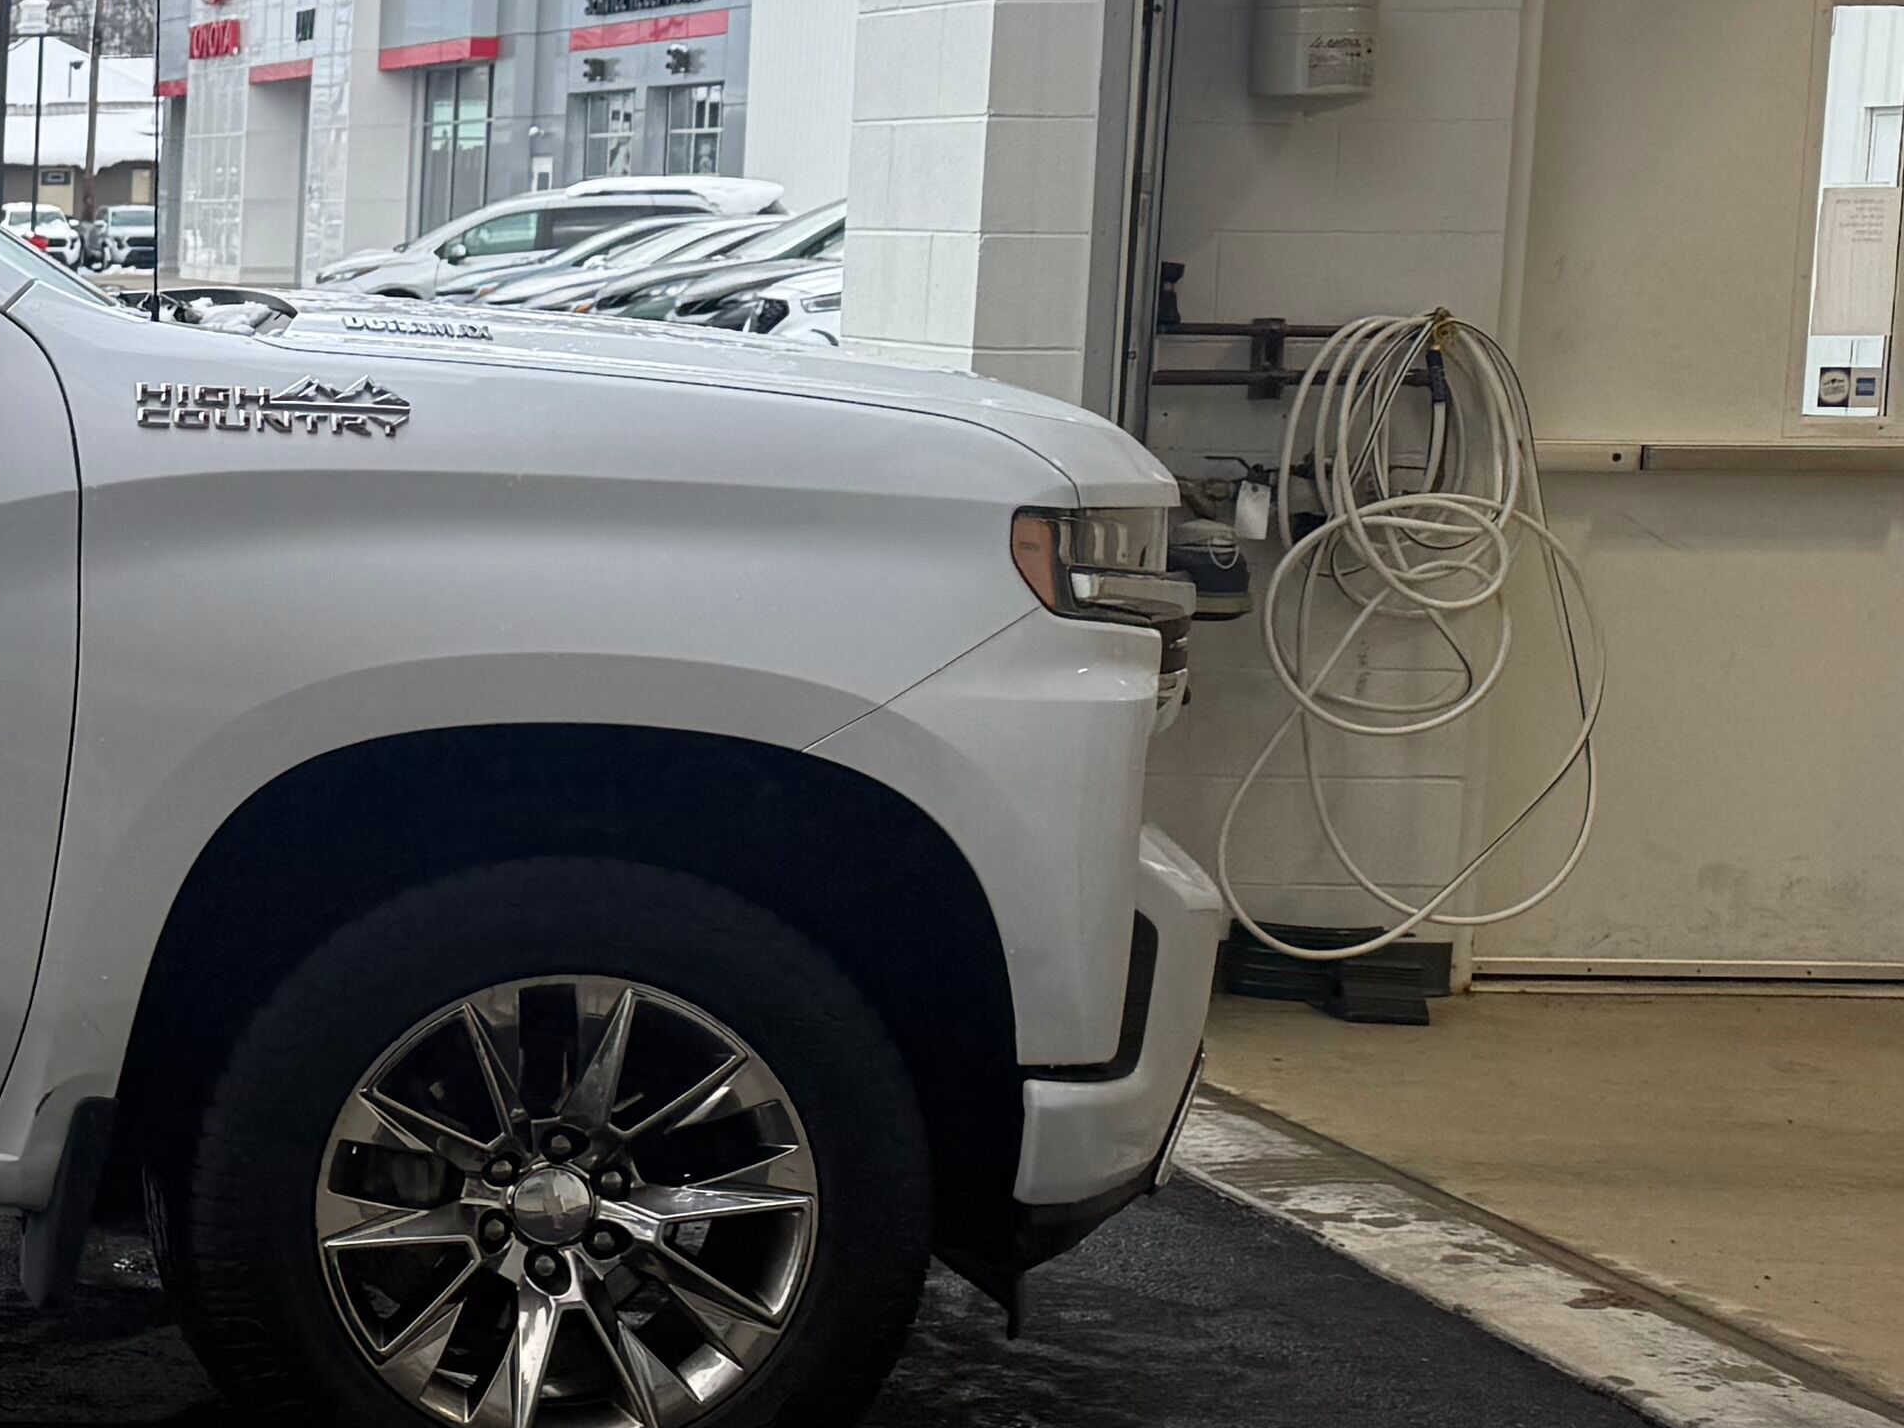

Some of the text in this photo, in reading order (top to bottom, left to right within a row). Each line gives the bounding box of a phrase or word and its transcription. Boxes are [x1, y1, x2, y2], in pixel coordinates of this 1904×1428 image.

[188, 18, 241, 60] TOYOTA
[136, 382, 271, 407] HIGH
[137, 407, 410, 437] COUNTRY
